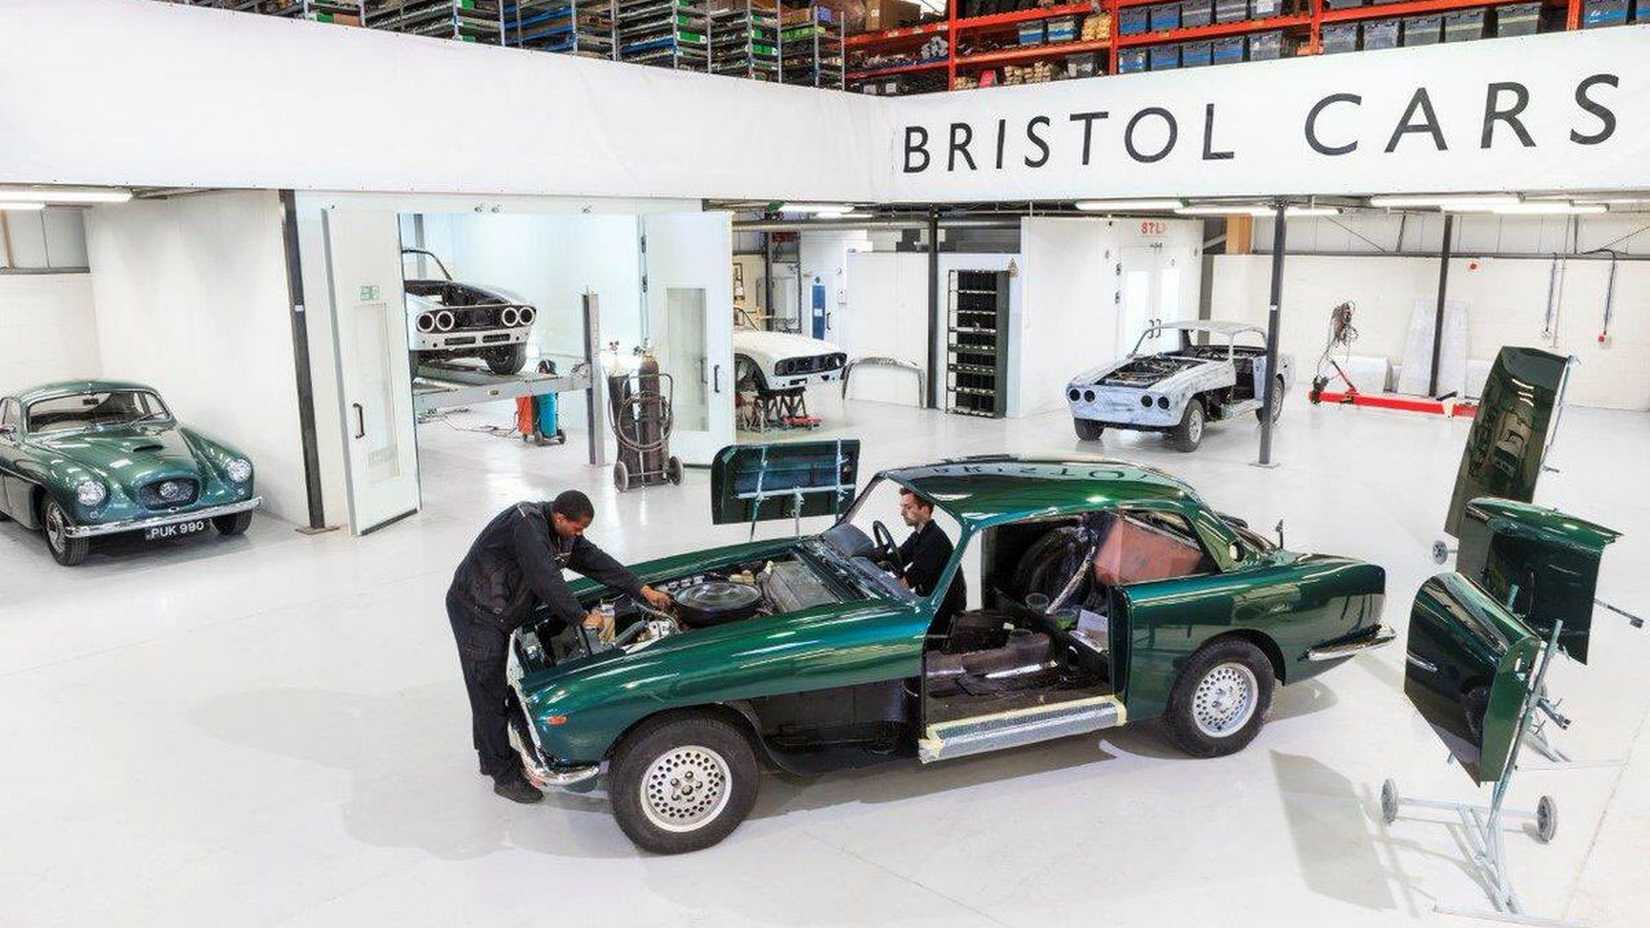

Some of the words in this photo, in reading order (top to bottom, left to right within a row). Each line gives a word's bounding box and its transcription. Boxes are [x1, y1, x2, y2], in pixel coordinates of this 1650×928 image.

[903, 103, 1235, 173] BRISTOL
[1304, 73, 1620, 157] CARS
[151, 525, 177, 539] PUK
[180, 520, 204, 534] 990
